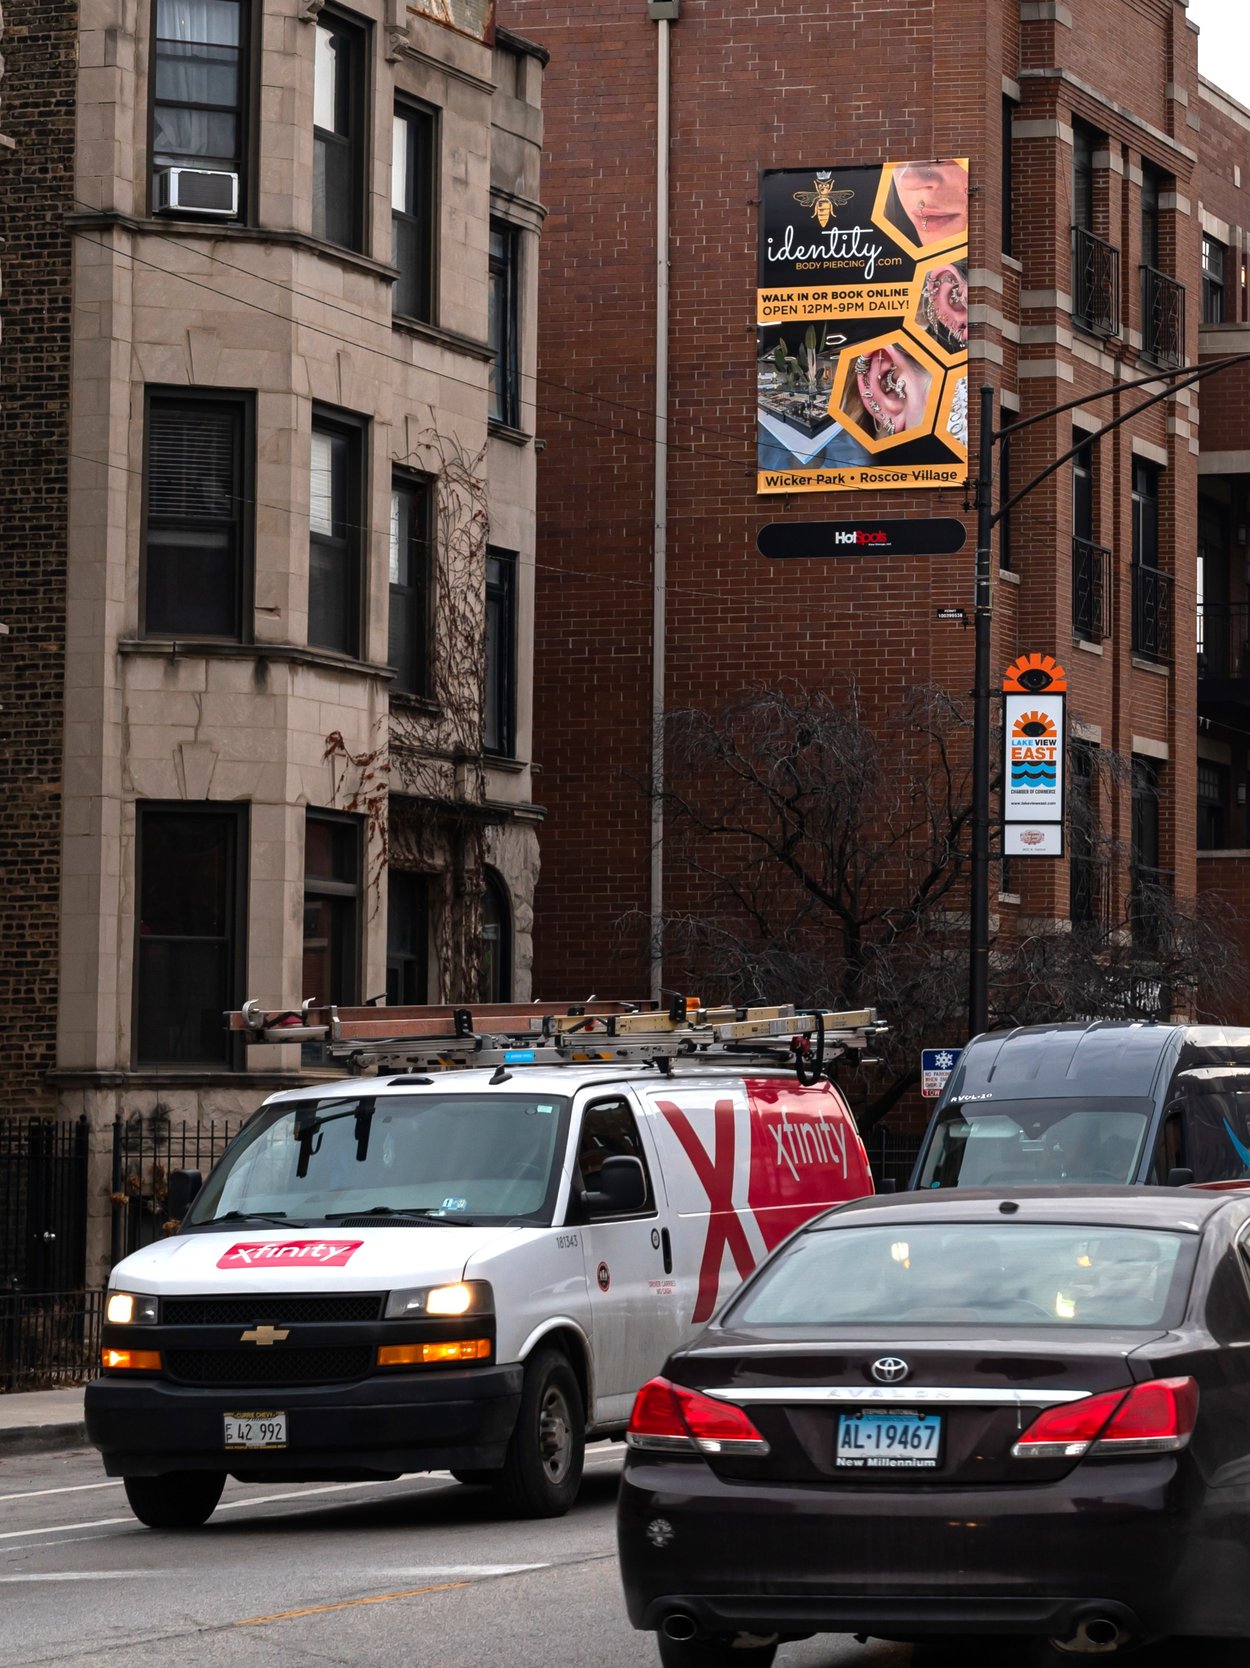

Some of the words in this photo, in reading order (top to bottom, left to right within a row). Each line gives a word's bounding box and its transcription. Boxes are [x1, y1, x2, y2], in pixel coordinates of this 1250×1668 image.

[767, 225, 882, 280] identity
[796, 261, 822, 270] BODY
[823, 259, 865, 269] PIERCING
[875, 257, 902, 267] .com
[761, 293, 794, 303] WALK
[797, 292, 809, 301] IN
[812, 291, 828, 300] OR
[831, 290, 863, 300] BOOK
[866, 288, 909, 298] ONLINE
[762, 305, 798, 315] OPEN
[802, 302, 864, 314] 12PM-9PM
[869, 300, 909, 311] DAILY!
[765, 475, 812, 486] Wicker
[816, 473, 846, 484] Park
[860, 472, 908, 483] Roscoe
[912, 469, 957, 482] Village
[835, 530, 888, 545] HotSpots
[1011, 747, 1057, 760] EAST
[768, 1105, 848, 1181] xfinity
[228, 1243, 351, 1264] xfinity
[826, 1389, 952, 1398] AVALON
[238, 1423, 252, 1441] 42
[260, 1423, 283, 1441] 992
[836, 1457, 865, 1467] New
[866, 1457, 936, 1467] Millennium
